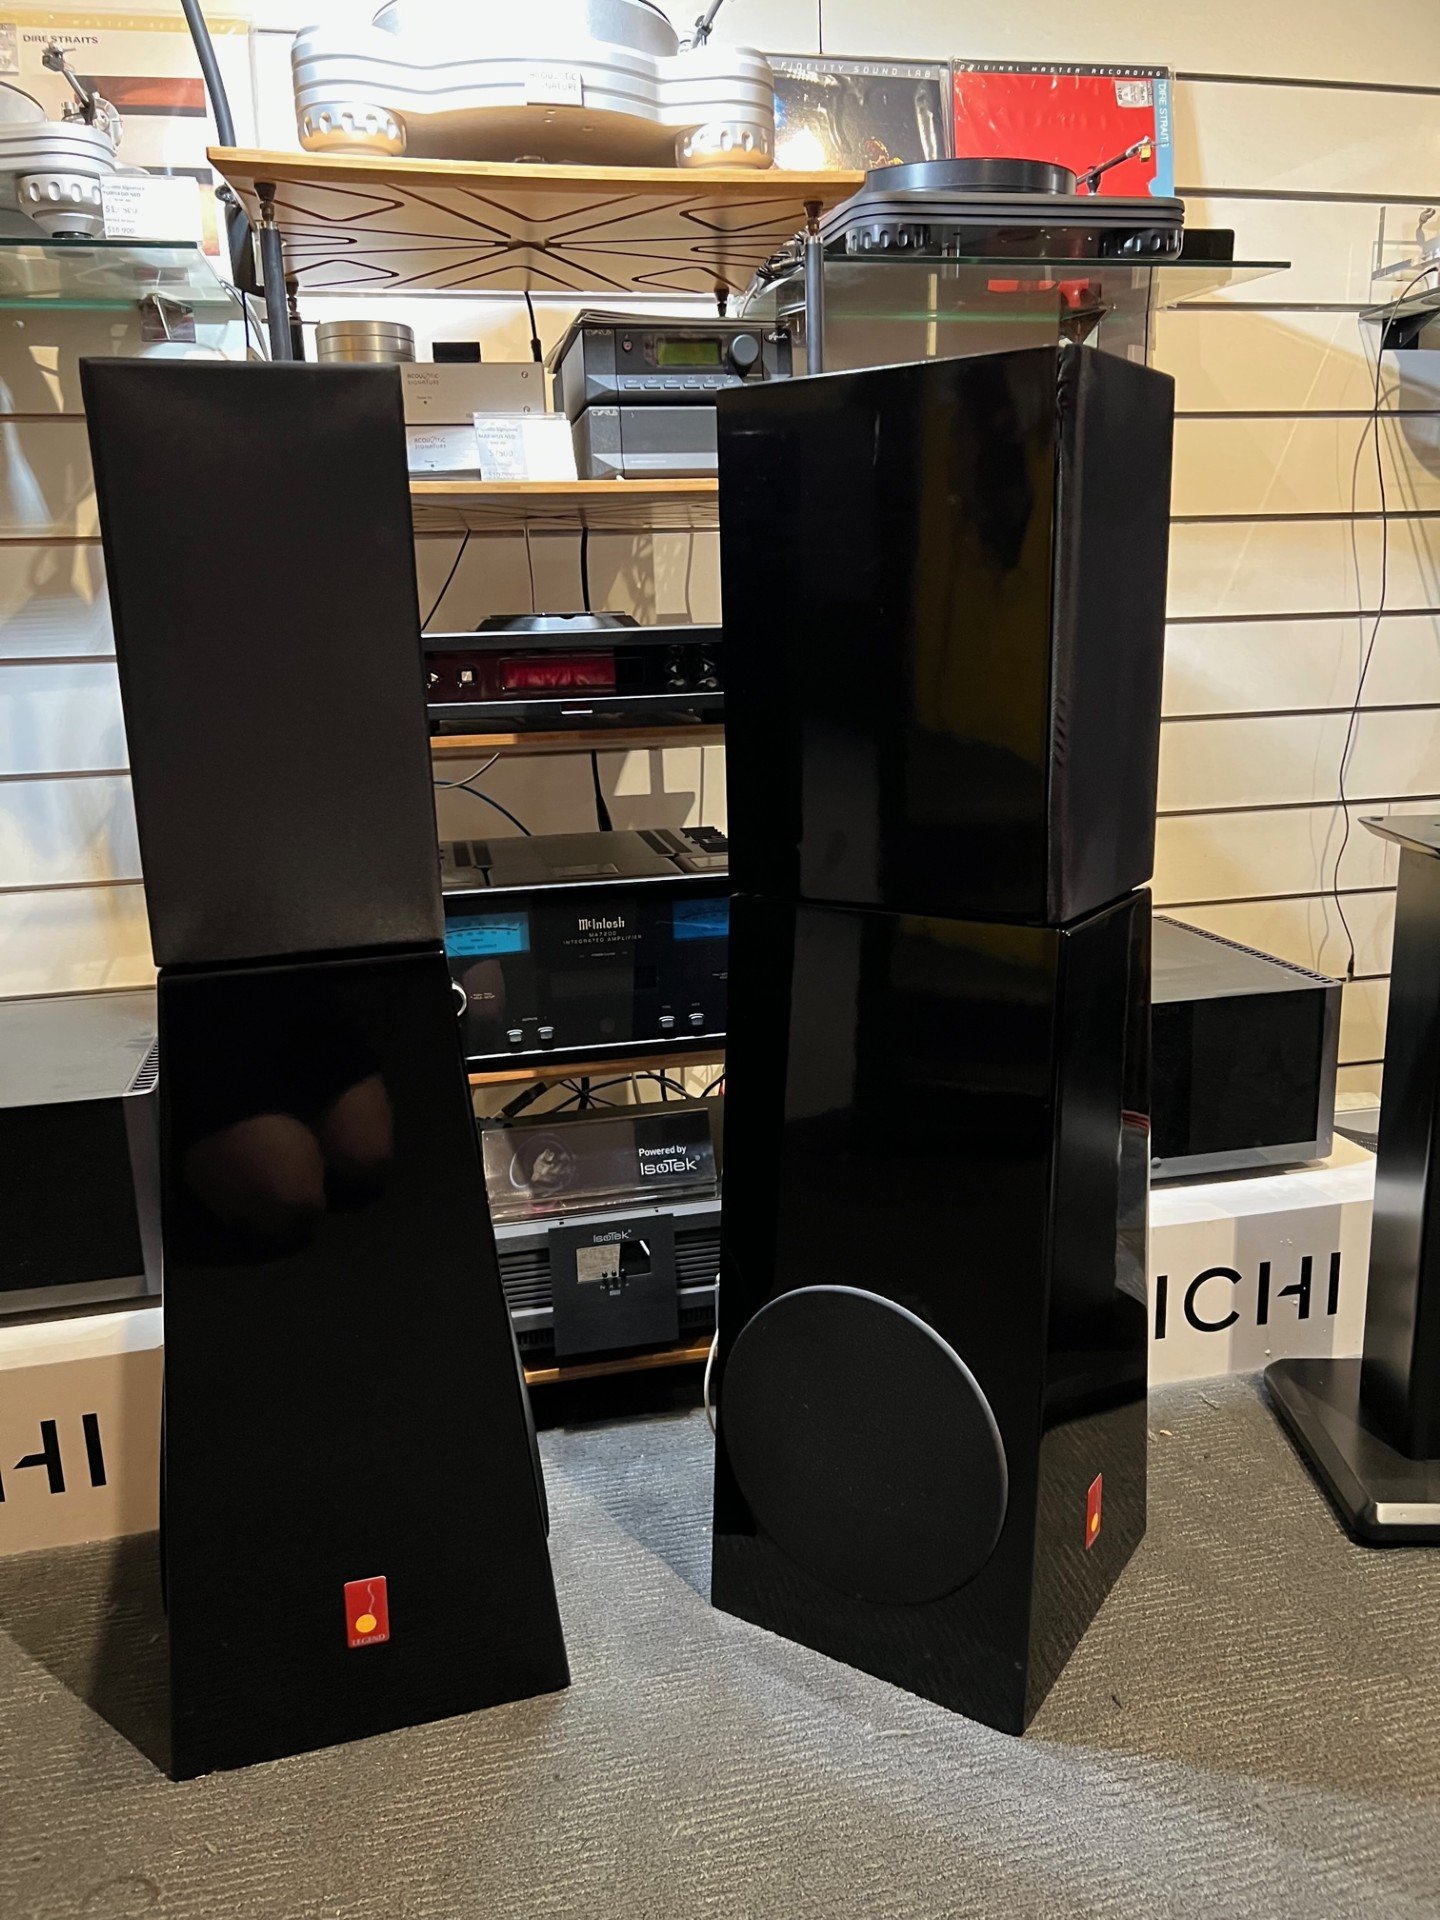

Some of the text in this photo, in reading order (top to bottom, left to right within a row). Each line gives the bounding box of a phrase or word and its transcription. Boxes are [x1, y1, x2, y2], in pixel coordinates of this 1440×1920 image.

[51, 35, 99, 44] STRAITS
[780, 61, 931, 78] FIDELITY SOUND LAB
[960, 64, 1162, 77] ORIGINAL MASTER RECORDING
[1158, 82, 1170, 148] DIRE STRAITS
[578, 916, 625, 931] McIntosh
[562, 934, 642, 945] INTEGRATED AMPLIFIER
[638, 1145, 687, 1157] Powered by
[640, 1157, 698, 1176] IsoTek
